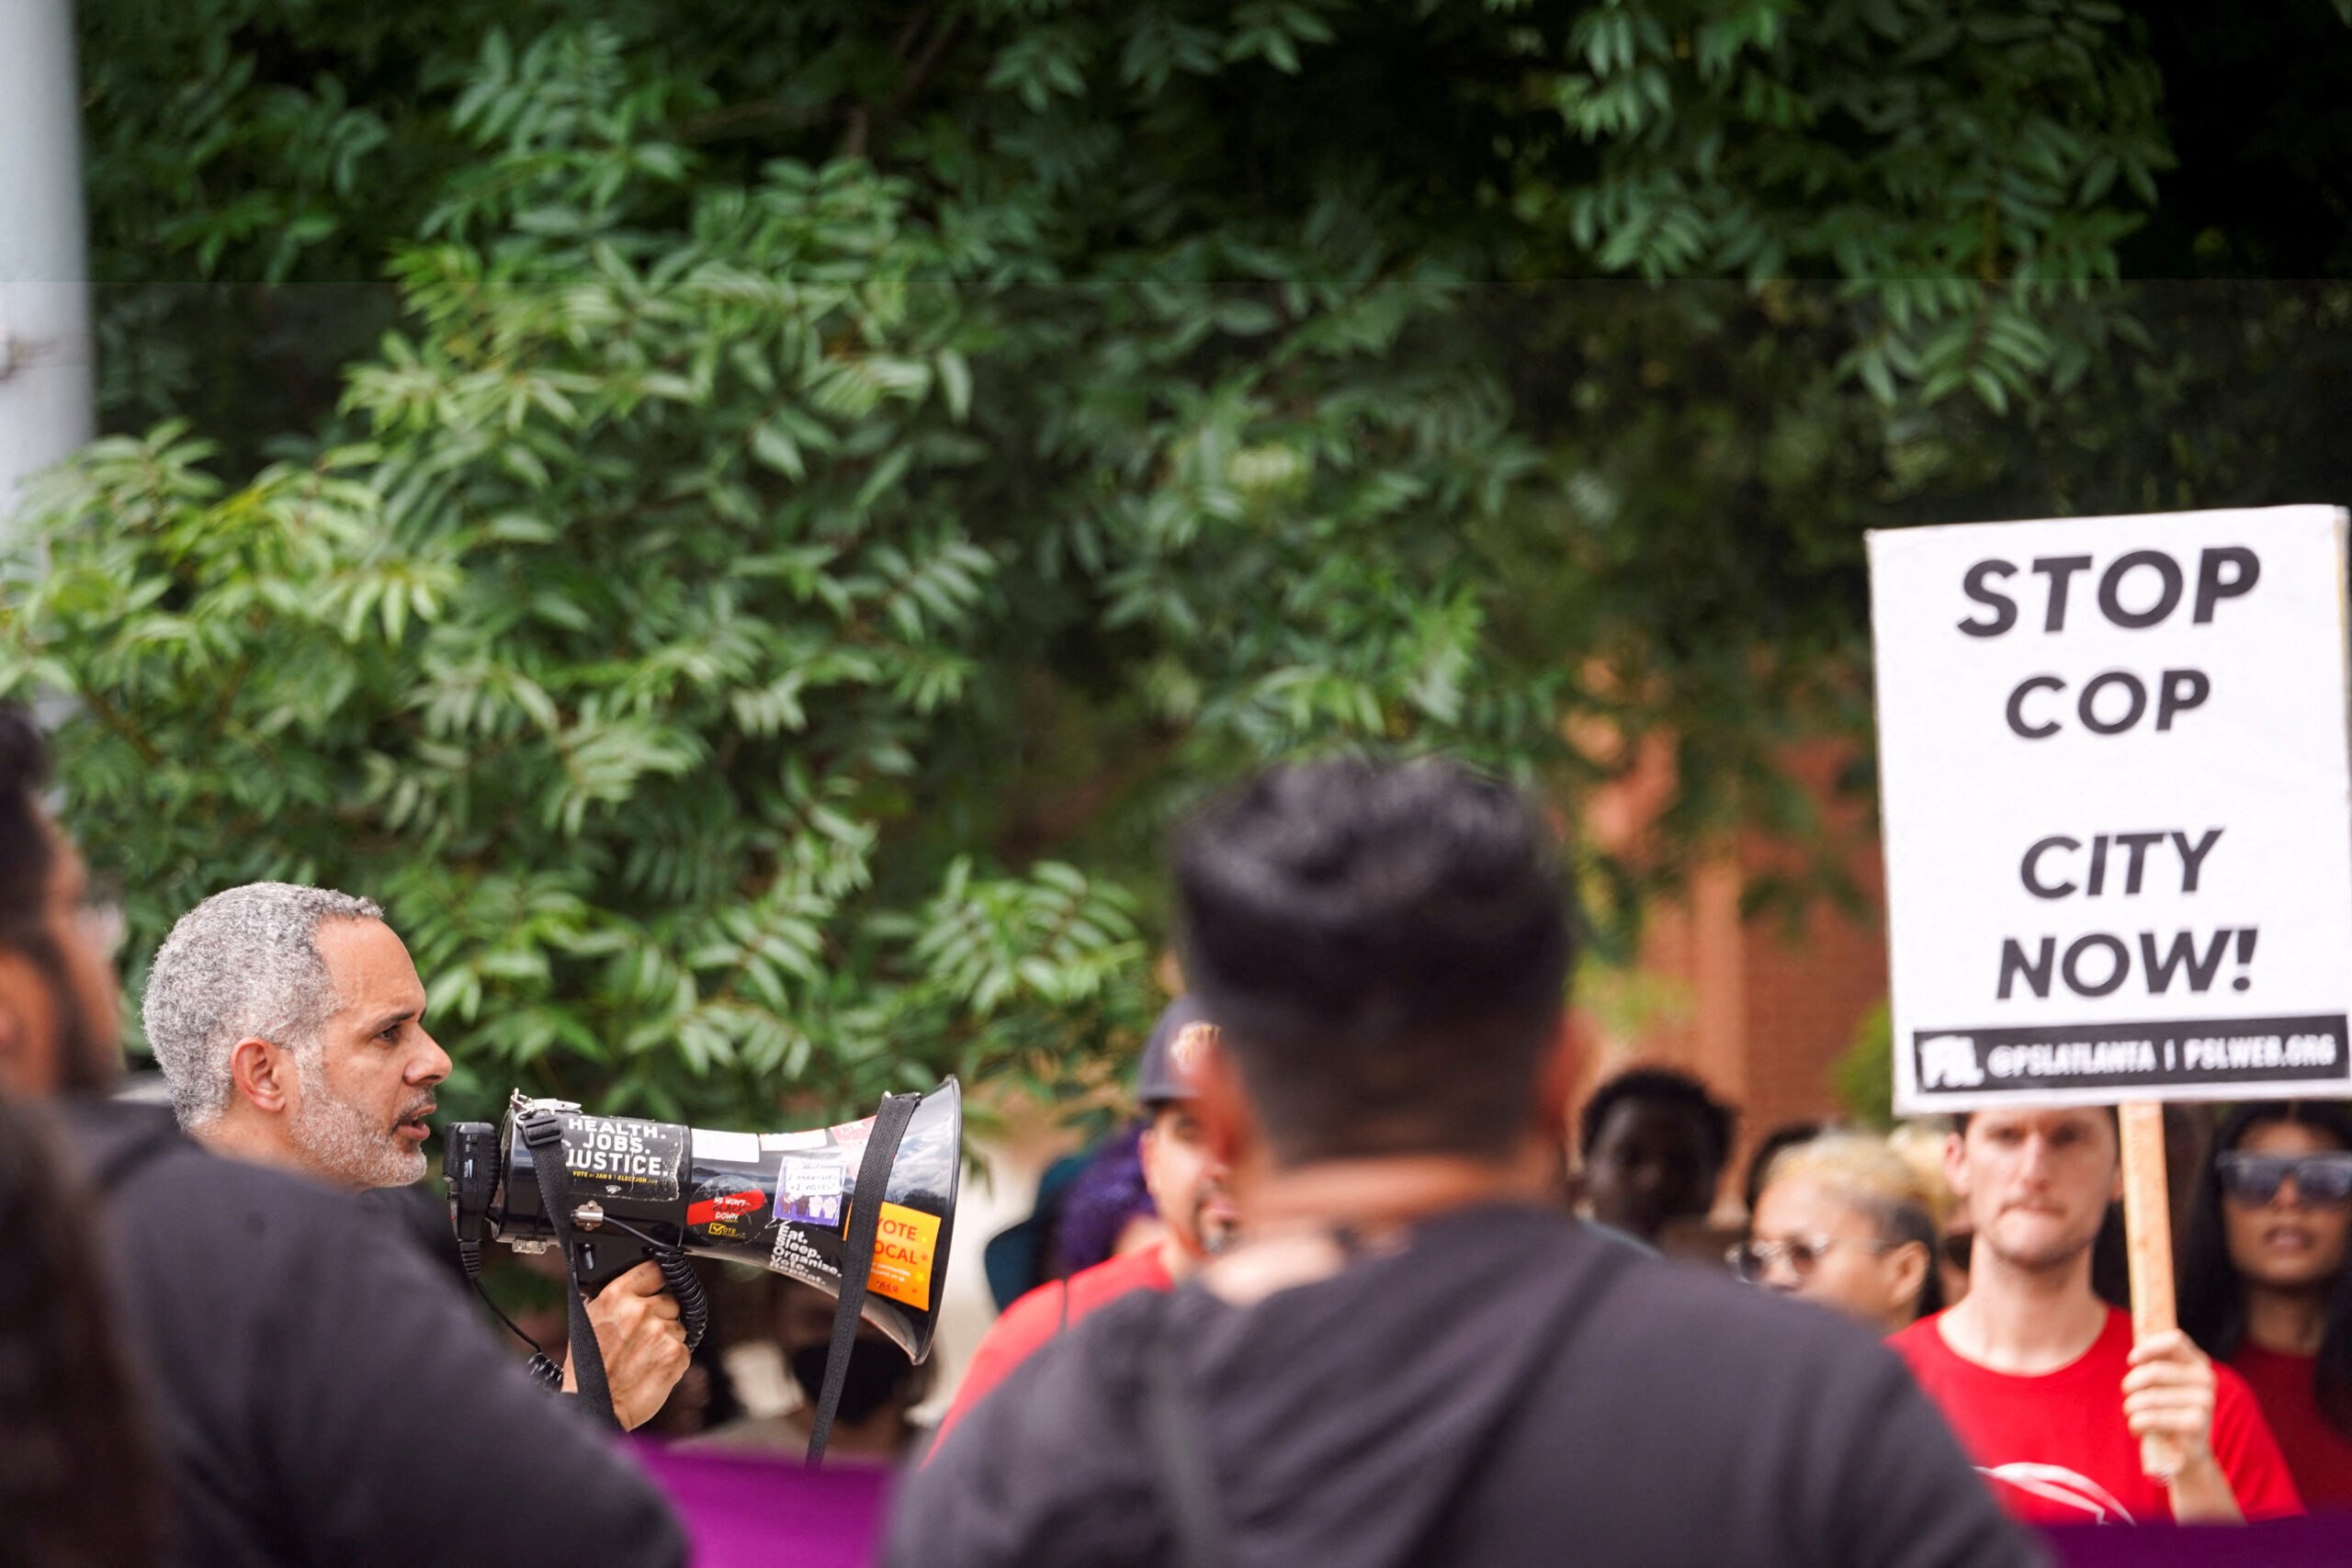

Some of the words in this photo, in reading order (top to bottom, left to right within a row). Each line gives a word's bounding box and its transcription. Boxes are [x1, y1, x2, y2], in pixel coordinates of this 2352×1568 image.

[1956, 546, 2261, 639] STOP
[2006, 669, 2211, 739] COP
[2021, 828, 2225, 899] CITY
[1996, 928, 2257, 1000] NOW!
[1987, 1040, 2157, 1077] @PSLATLANTA
[2183, 1033, 2336, 1071] PSLWEB.ORG
[568, 1118, 667, 1139] HEALTH.
[582, 1132, 650, 1155] JOBS.
[565, 1148, 669, 1177] JUSTICE.
[715, 1212, 739, 1220] DOWN
[775, 1235, 821, 1259] Sleep.
[778, 1224, 808, 1245] Eat.
[770, 1255, 808, 1273] Vote.
[773, 1246, 842, 1278] Organize.
[874, 1240, 918, 1265] OCAL
